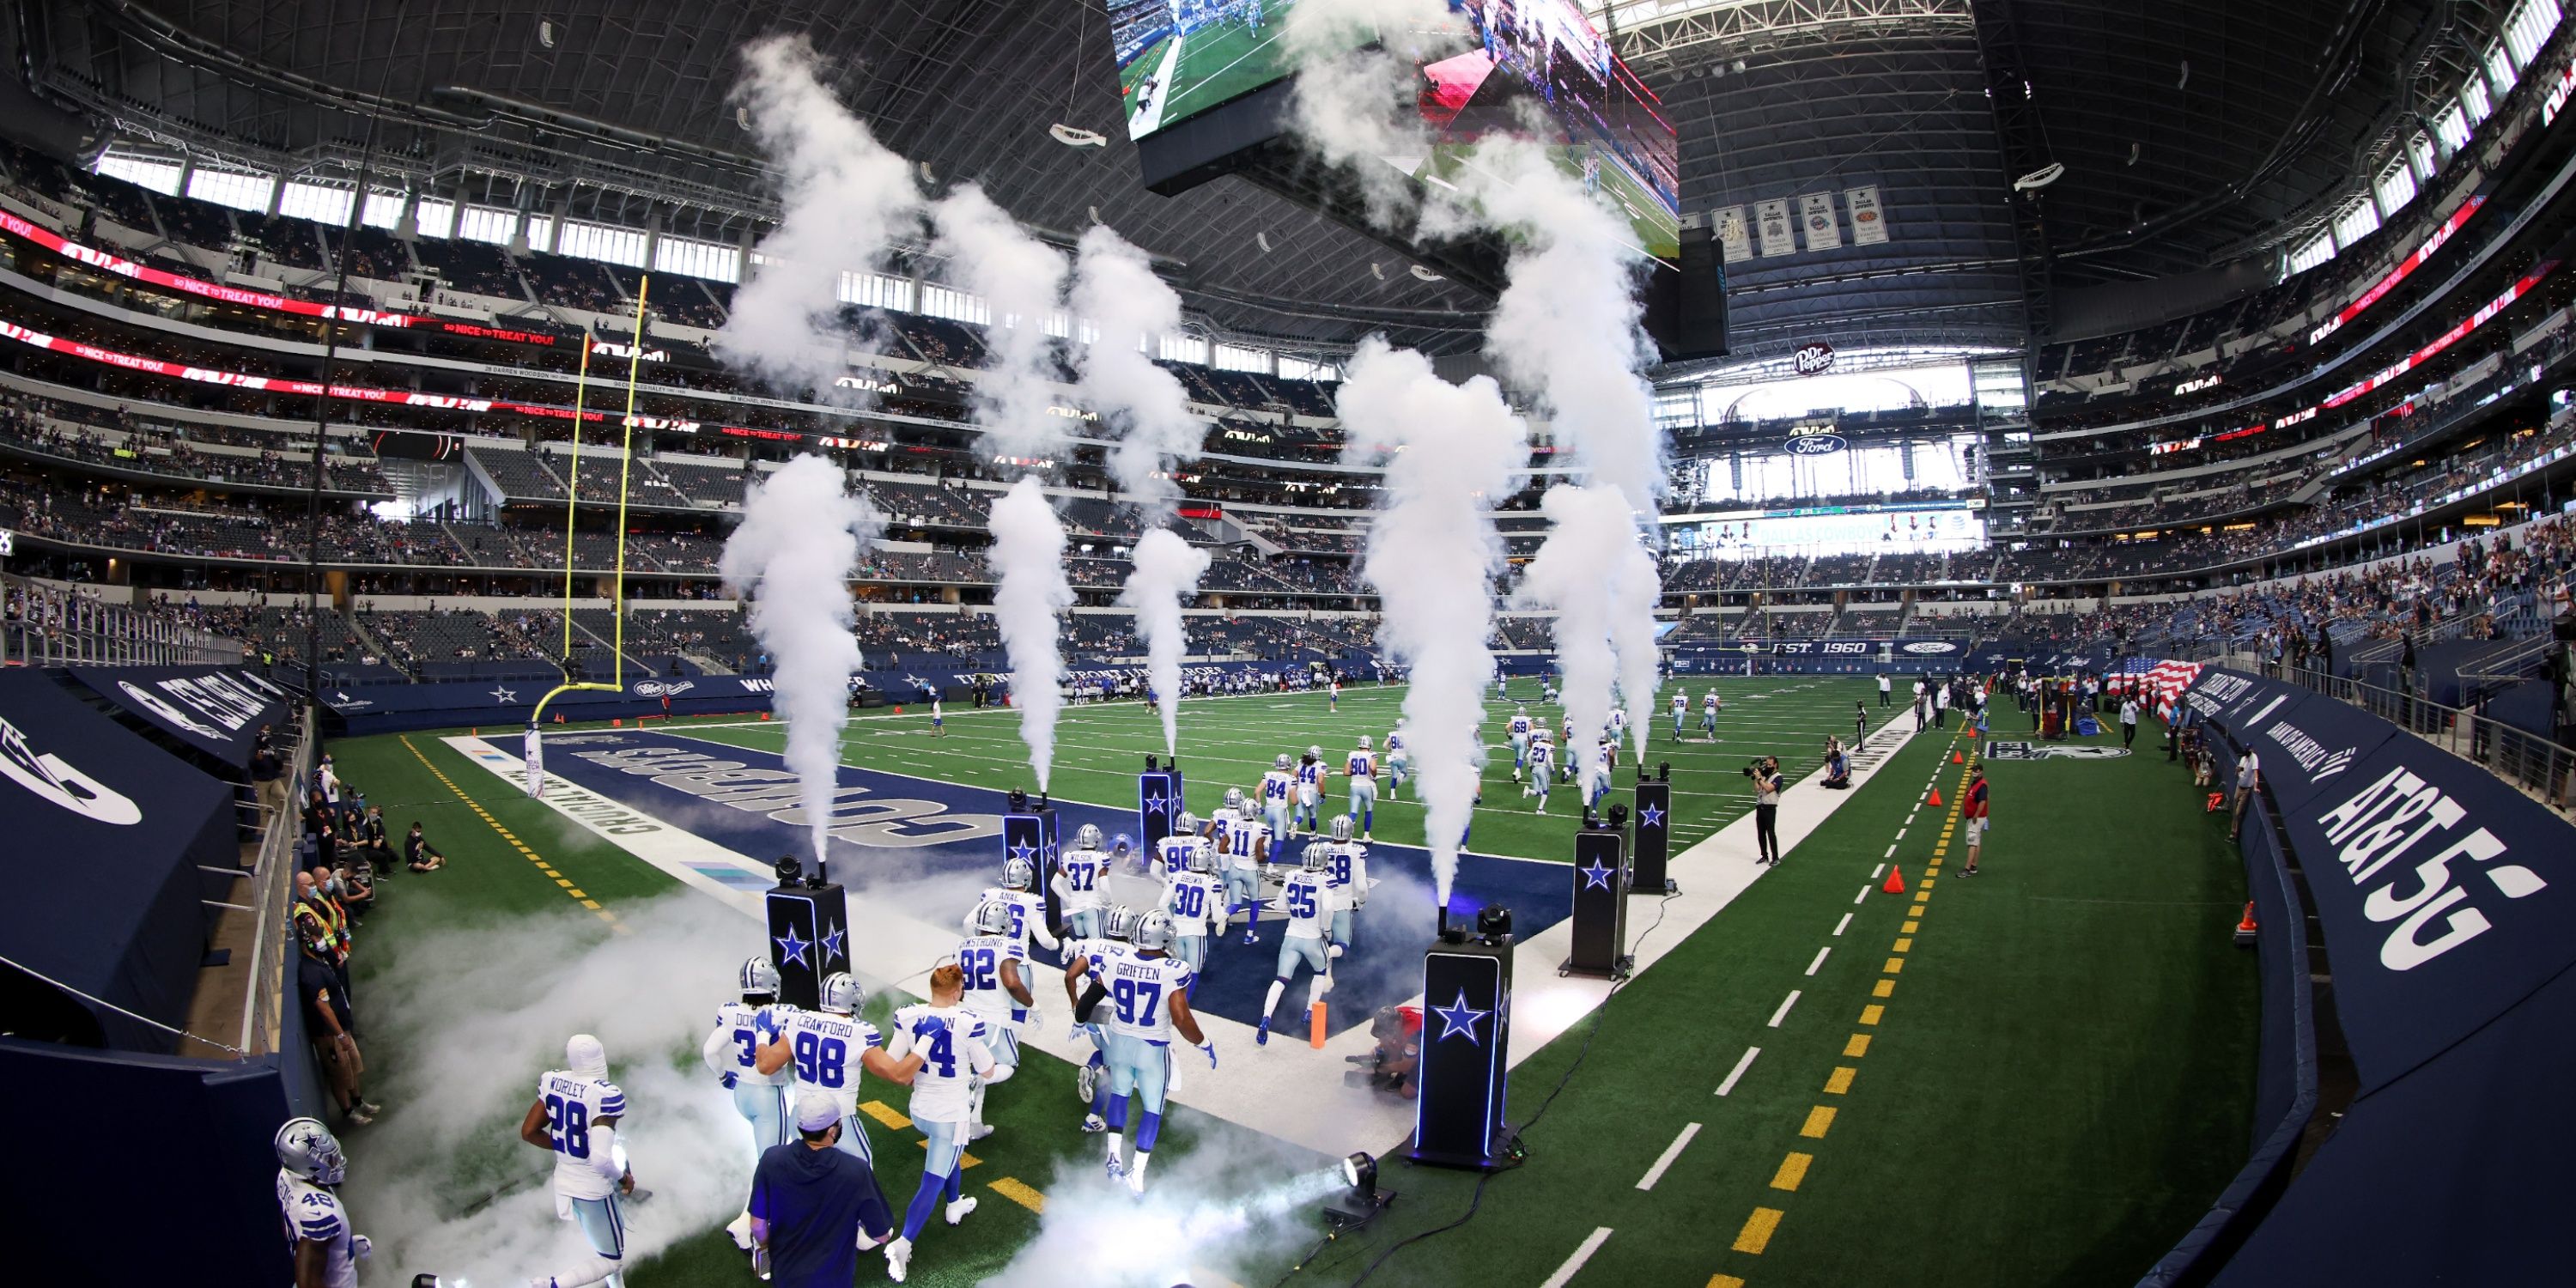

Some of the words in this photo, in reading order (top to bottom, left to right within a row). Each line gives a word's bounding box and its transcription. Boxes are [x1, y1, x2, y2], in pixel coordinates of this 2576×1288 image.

[7, 216, 33, 237] YOU!
[173, 278, 184, 287] SO
[185, 281, 209, 295] NICE
[210, 288, 220, 296] TO
[221, 289, 255, 306] TREAT
[257, 295, 283, 308] YOU!
[455, 325, 481, 336] NICE
[493, 330, 525, 343] TREAT
[527, 333, 554, 345] YOU!
[84, 347, 104, 360] NICE
[113, 355, 141, 368] TREAT
[142, 361, 164, 372] YOU!
[1797, 349, 1833, 372] Pepper
[1808, 347, 1823, 357] Dr
[519, 370, 550, 379] WOODSON
[301, 386, 323, 394] NICE
[333, 386, 361, 398] TREAT
[363, 390, 386, 400] YOU!
[622, 382, 648, 391] CHRLES
[524, 407, 544, 416] NICE
[581, 411, 604, 422] YOU!
[1796, 437, 1834, 453] Ford
[1822, 643, 1867, 653] 1960
[1514, 722, 1527, 733] 69
[1533, 747, 1546, 763] 23
[2266, 721, 2296, 744] BANK
[2287, 735, 2330, 772] AMERICA
[1299, 764, 1316, 783] 44
[1351, 757, 1367, 775] 80
[1266, 778, 1286, 799] 84
[544, 790, 664, 835] CRUCIAL
[2318, 765, 2468, 885] AT&T
[1232, 829, 1249, 856] 11
[1071, 854, 1092, 862] WILSON
[1069, 863, 1095, 890] 37
[1181, 875, 1203, 884] BROWN
[1294, 873, 1314, 884] WOODS
[1175, 884, 1205, 918] 30
[1287, 883, 1317, 919] 25
[2364, 826, 2548, 971] 5G
[961, 949, 996, 990] 92
[1116, 963, 1160, 980] GRIFFEN
[1113, 979, 1161, 1027] 97
[736, 1012, 757, 1027] DOW
[798, 1014, 853, 1037] CRAWFORD
[795, 1031, 847, 1088] 98
[550, 1076, 586, 1099] WORLEY
[544, 1094, 591, 1158] 28
[301, 1193, 335, 1209] 48
